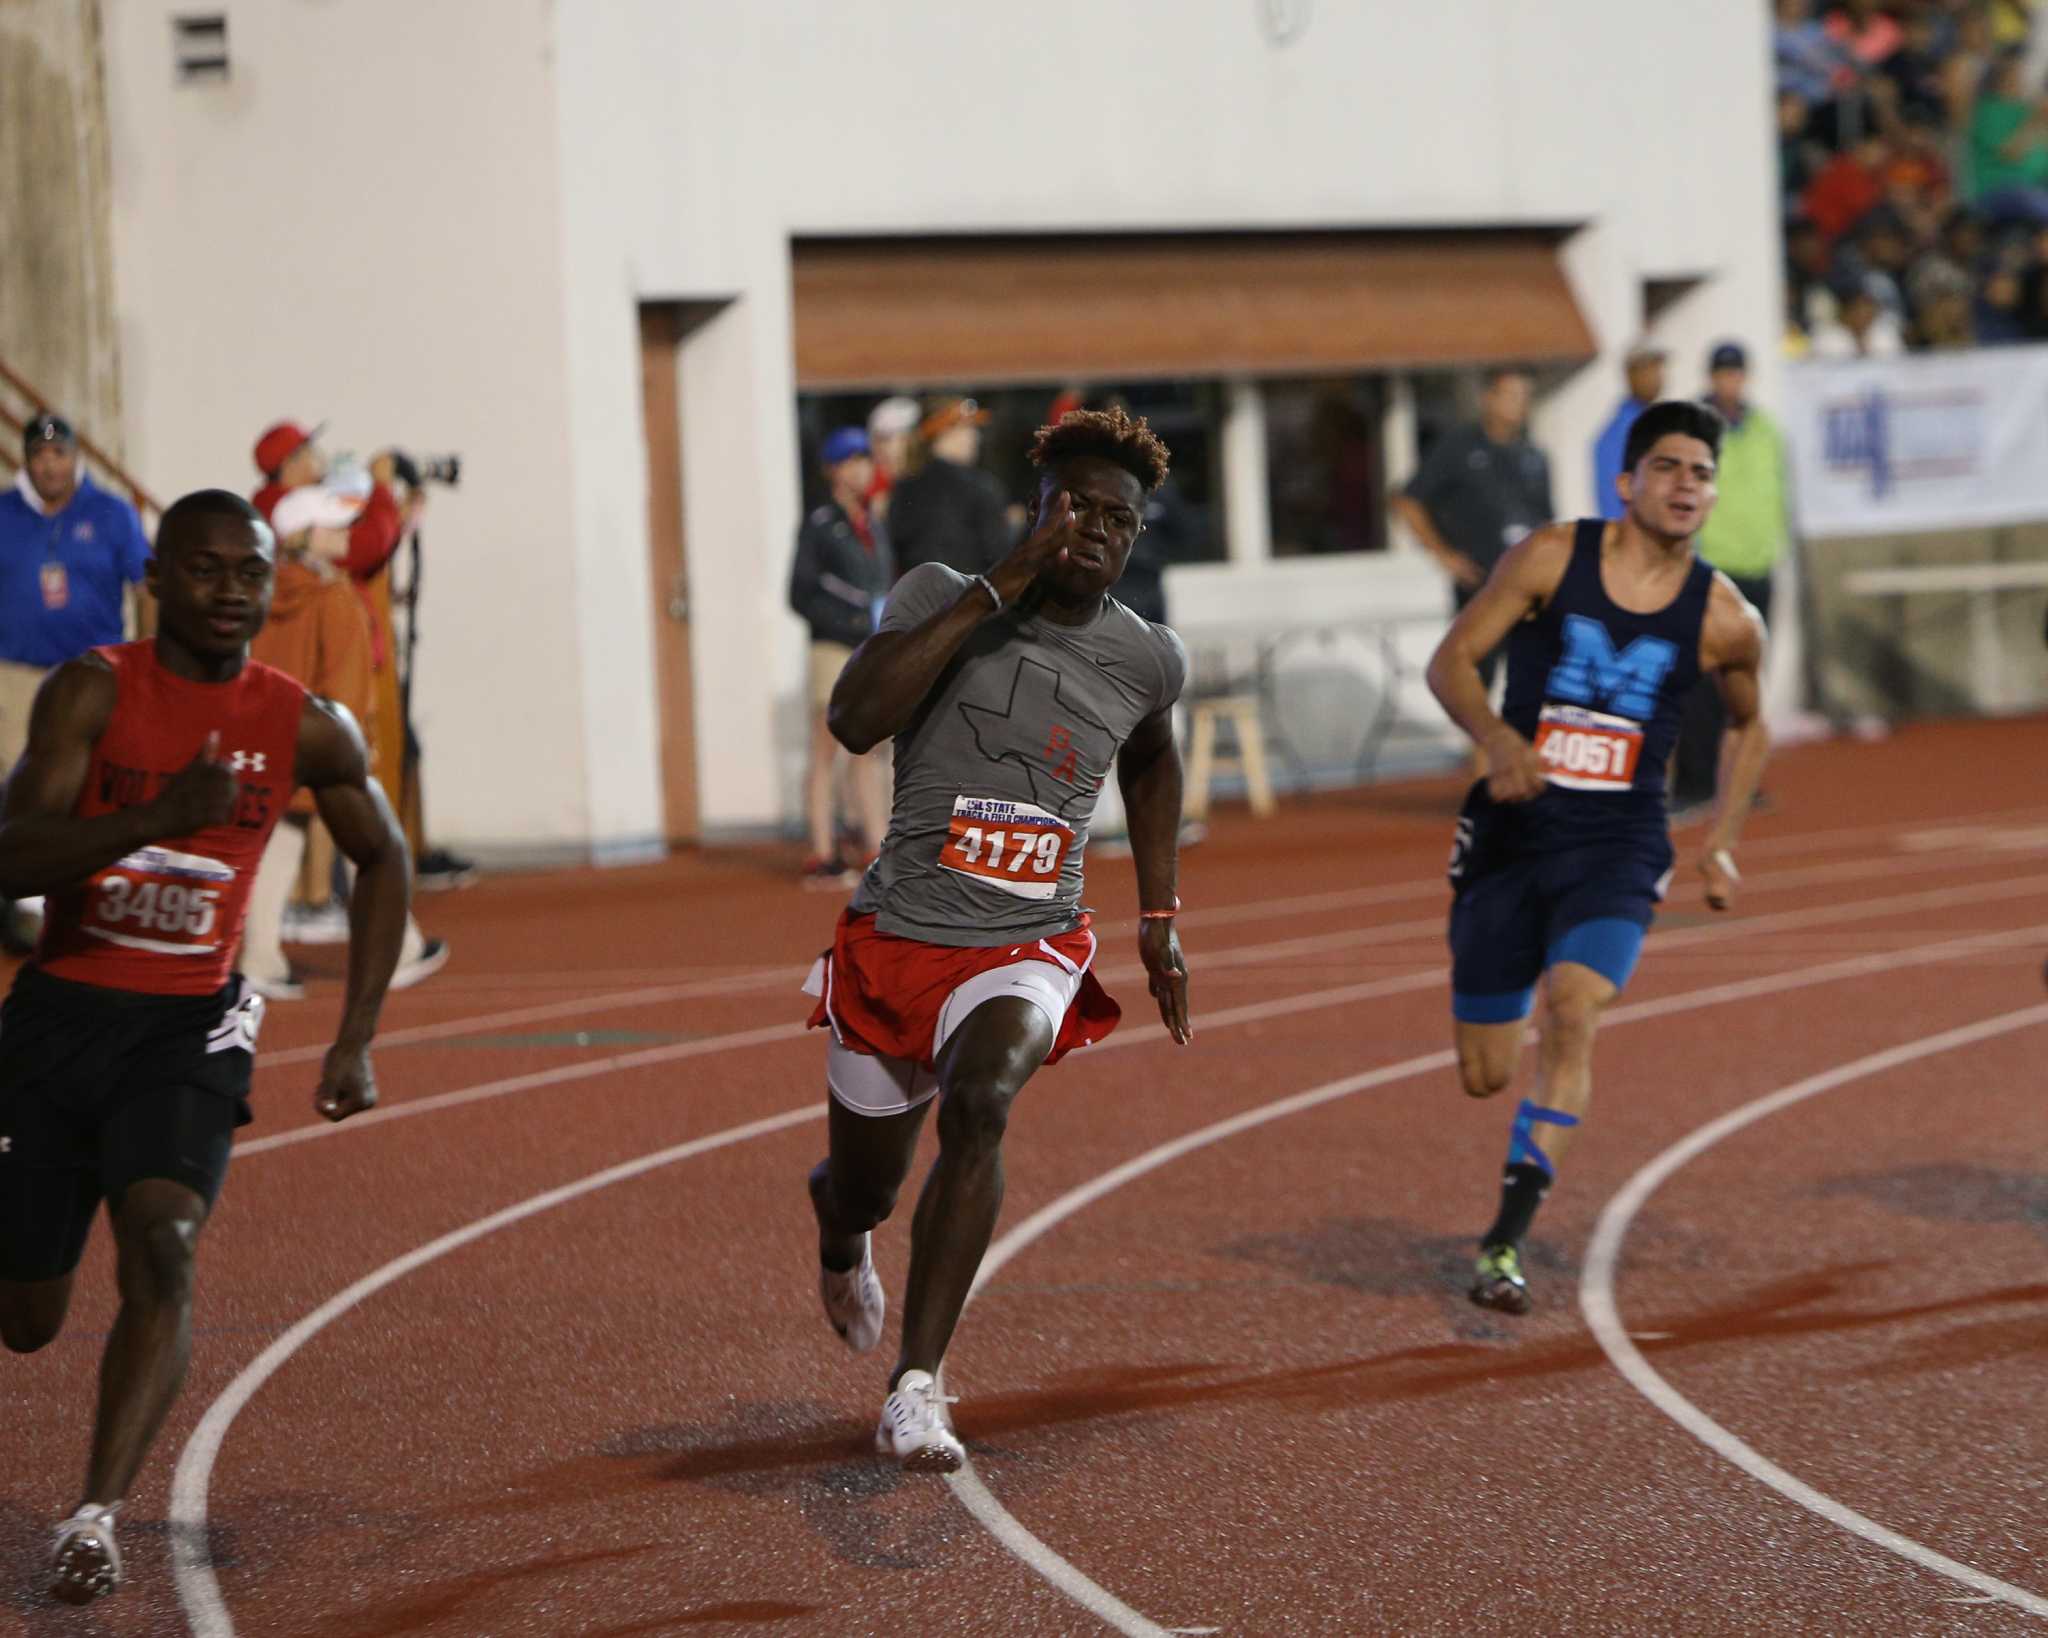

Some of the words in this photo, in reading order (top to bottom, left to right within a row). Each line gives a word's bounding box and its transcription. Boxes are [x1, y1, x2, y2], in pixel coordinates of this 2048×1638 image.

[1540, 730, 1629, 776] 4051
[957, 809, 982, 820] TRACK
[991, 813, 1012, 823] FIELD
[985, 801, 1016, 814] STATE
[954, 827, 1061, 874] 4179
[96, 875, 221, 936] 3495
